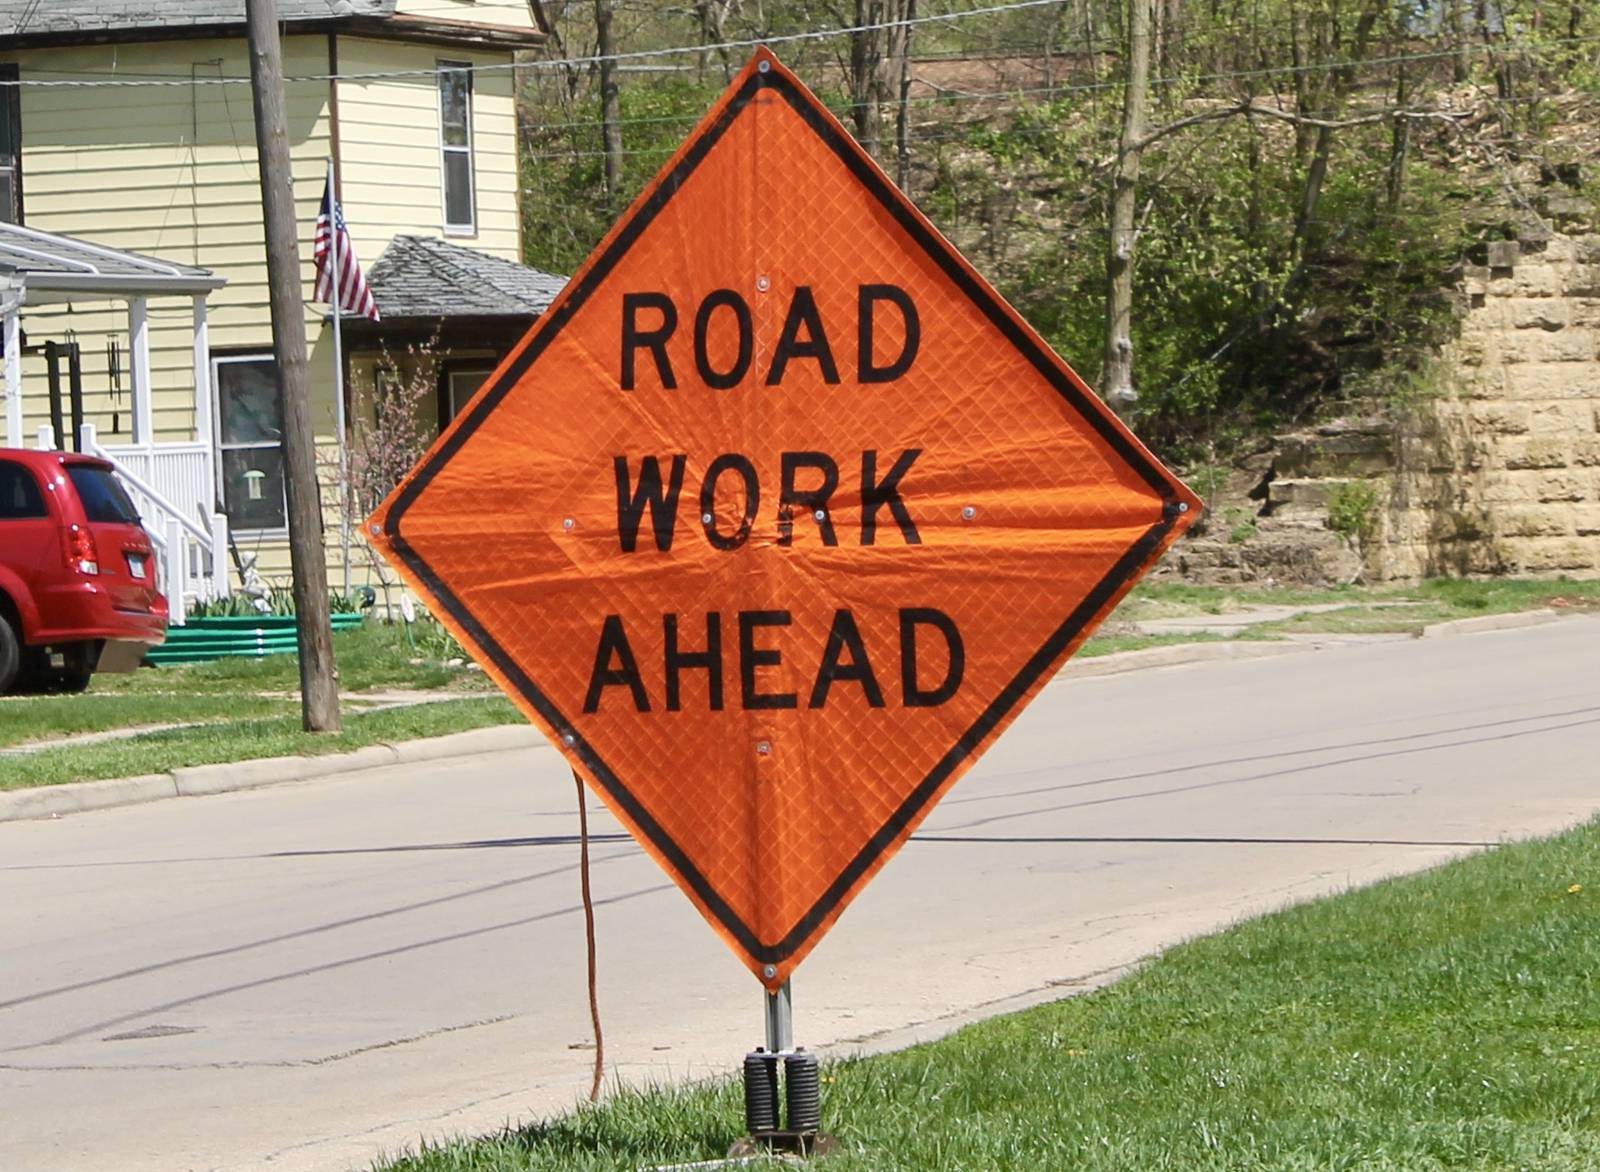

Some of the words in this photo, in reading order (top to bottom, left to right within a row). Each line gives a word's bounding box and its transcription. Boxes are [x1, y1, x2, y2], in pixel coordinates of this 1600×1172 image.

[620, 284, 921, 391] ROAD
[614, 449, 923, 552] WORK
[582, 607, 965, 713] AHEAD
